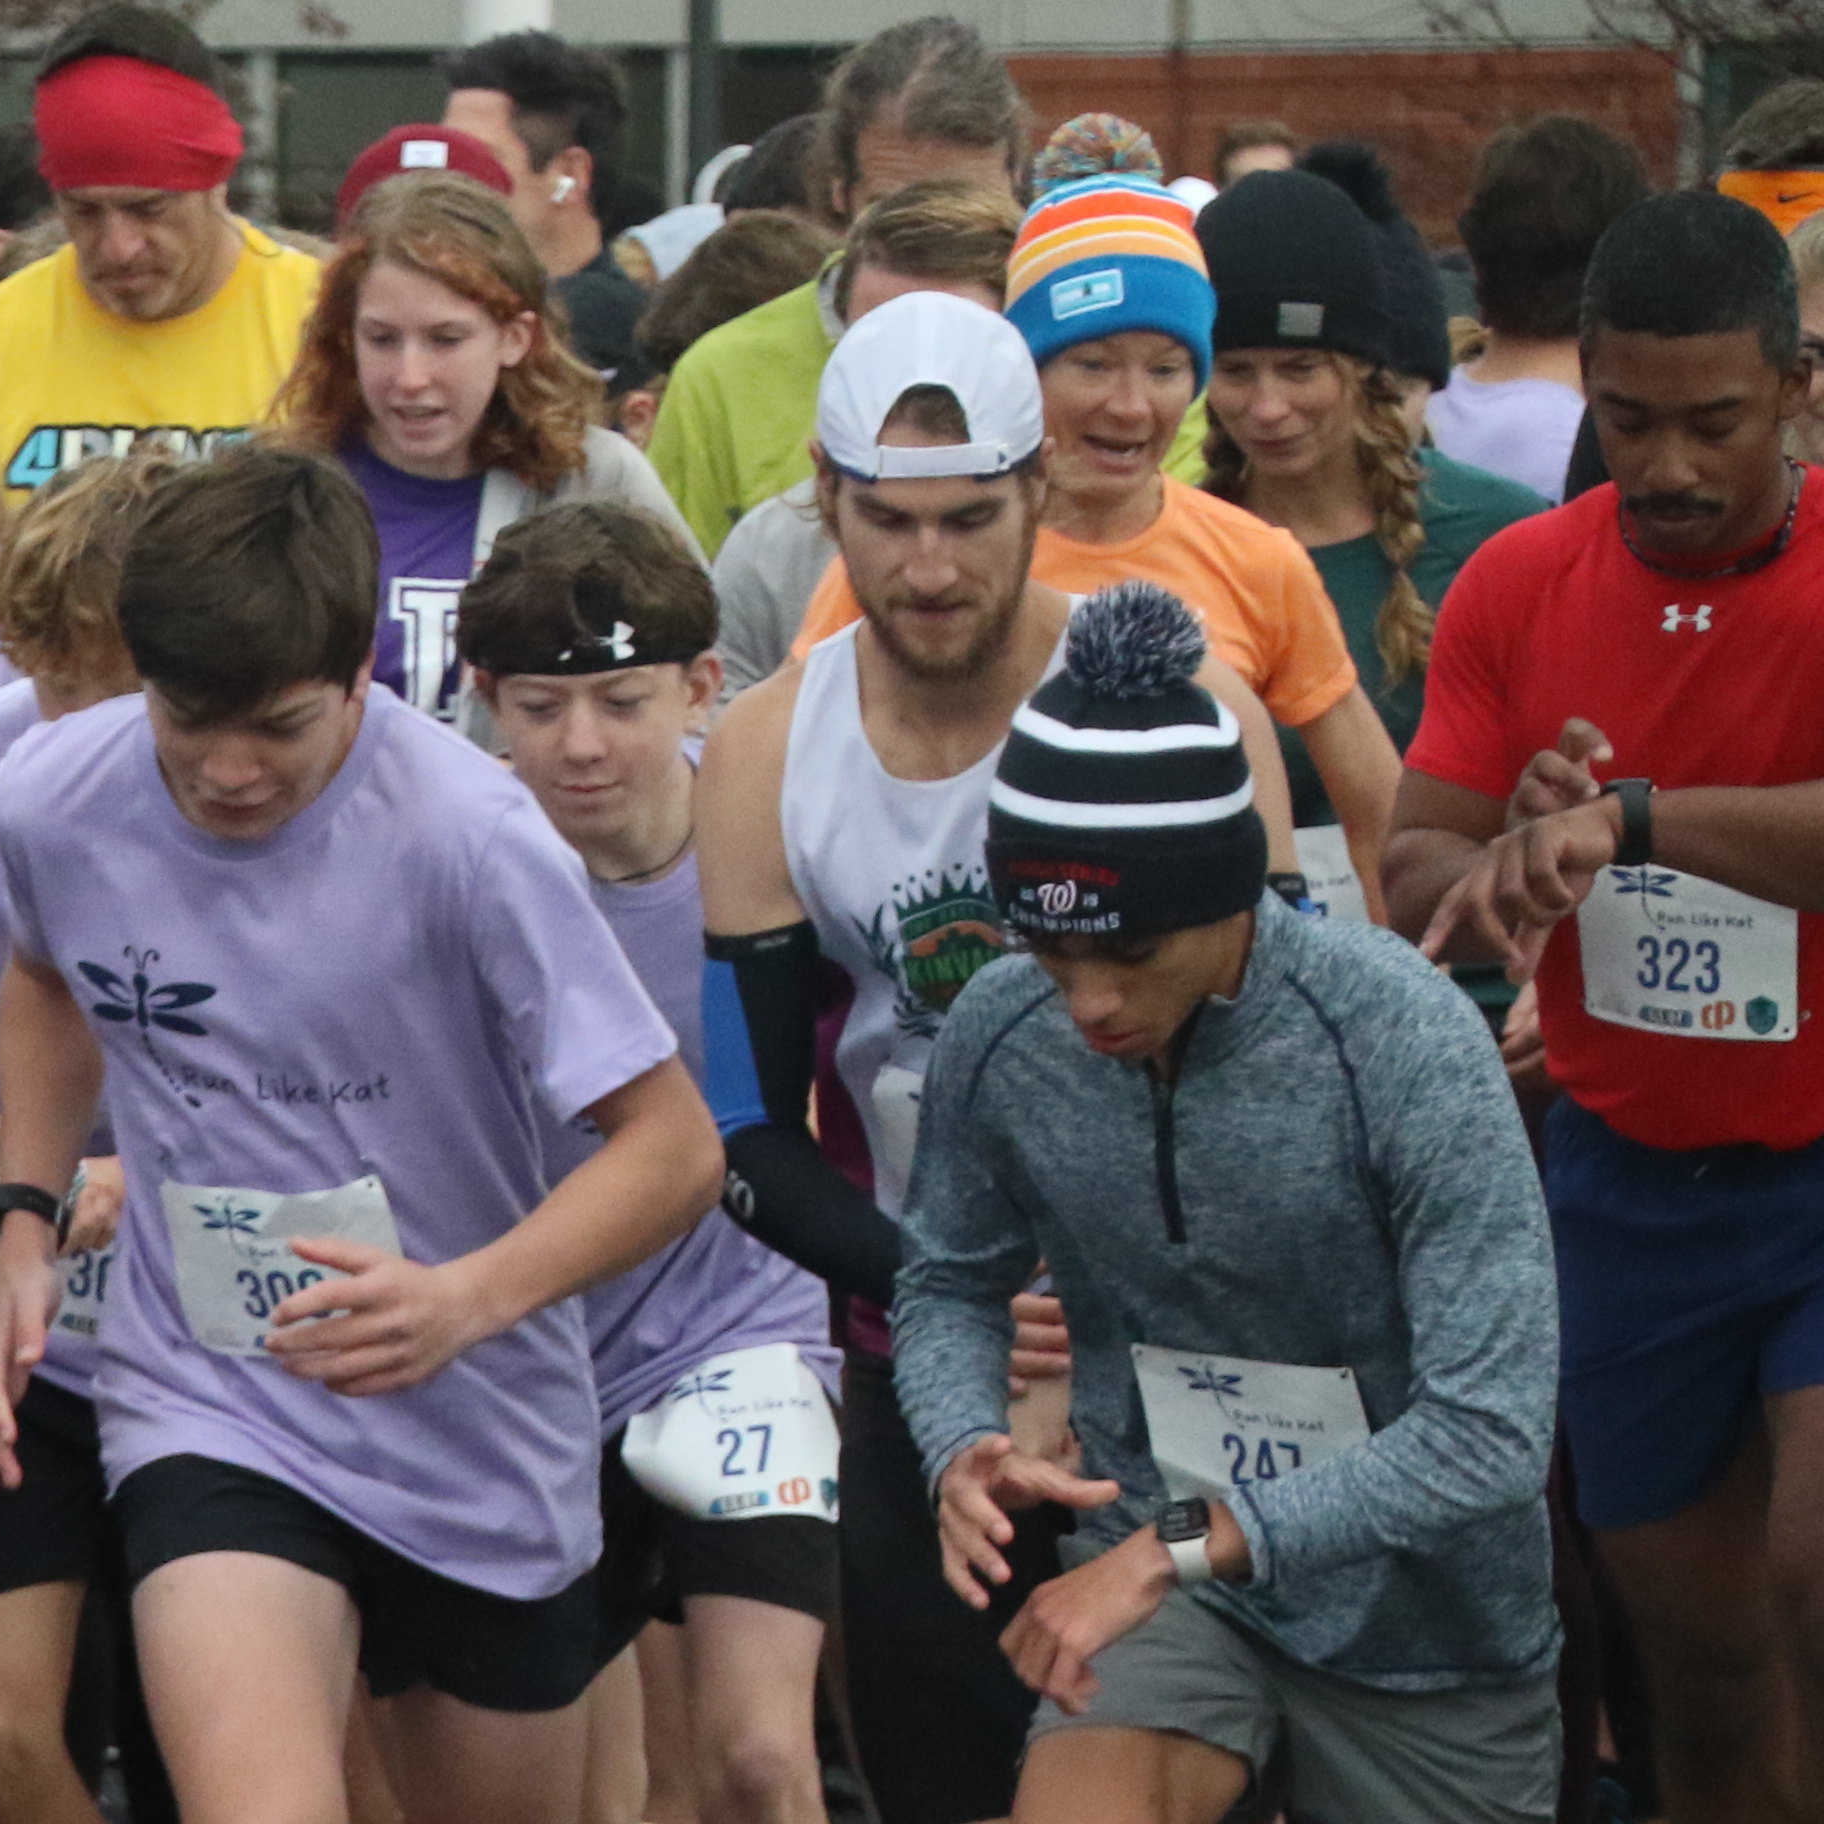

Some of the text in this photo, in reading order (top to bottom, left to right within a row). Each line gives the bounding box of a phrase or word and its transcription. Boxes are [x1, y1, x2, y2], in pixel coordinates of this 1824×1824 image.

[1657, 910, 1685, 924] Run
[1691, 912, 1720, 927] Like
[1636, 935, 1721, 994] 323
[180, 1063, 390, 1105] Run Like Kat
[717, 1424, 772, 1476] 27
